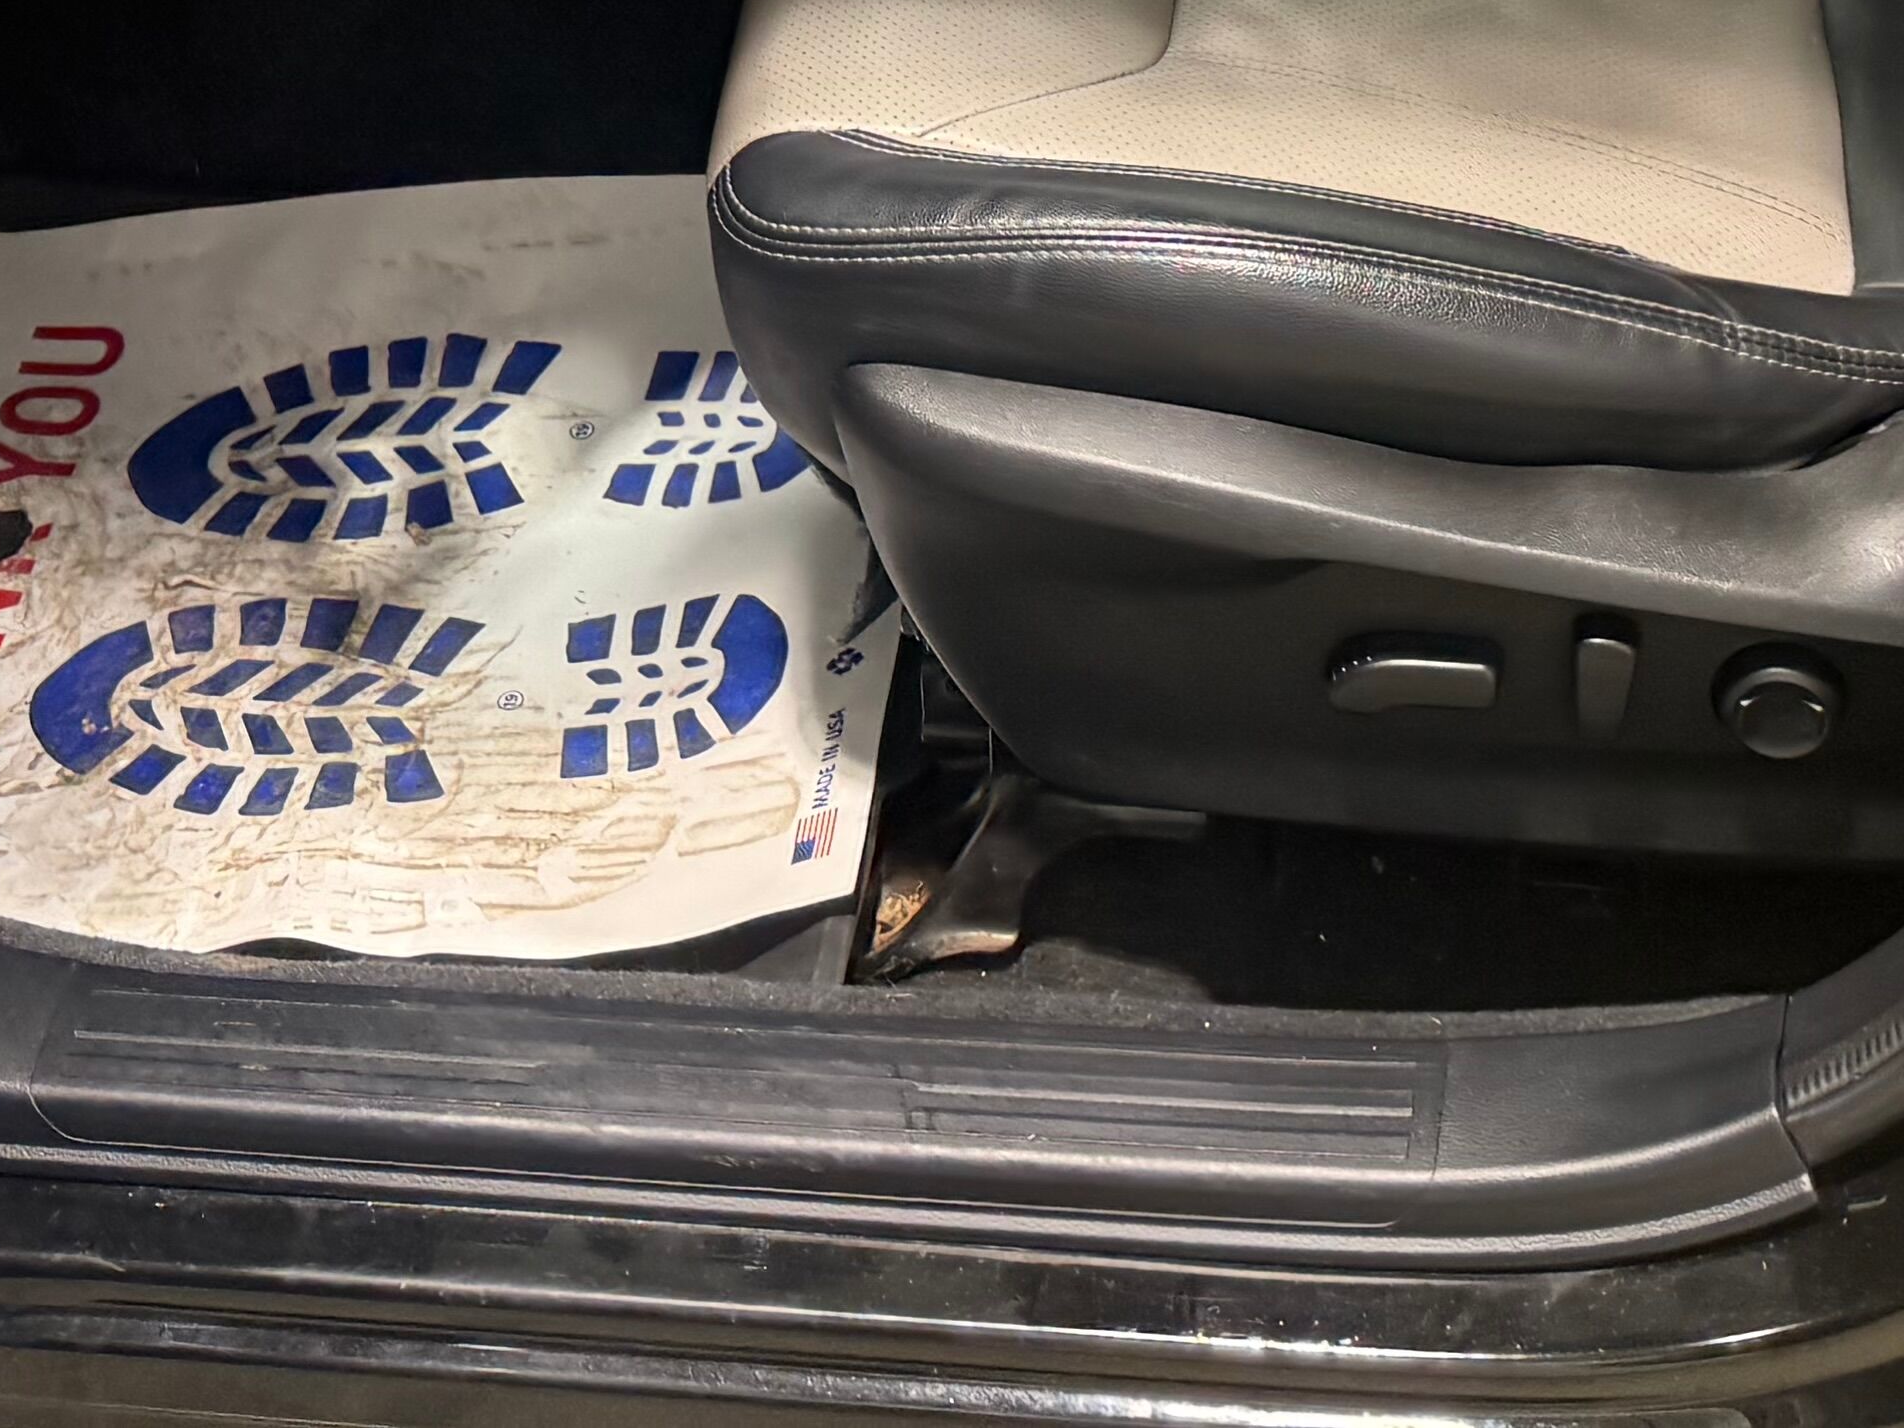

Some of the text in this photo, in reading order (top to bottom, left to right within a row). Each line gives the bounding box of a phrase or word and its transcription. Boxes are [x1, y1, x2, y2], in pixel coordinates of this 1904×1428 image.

[811, 707, 846, 810] MADE IN USA
